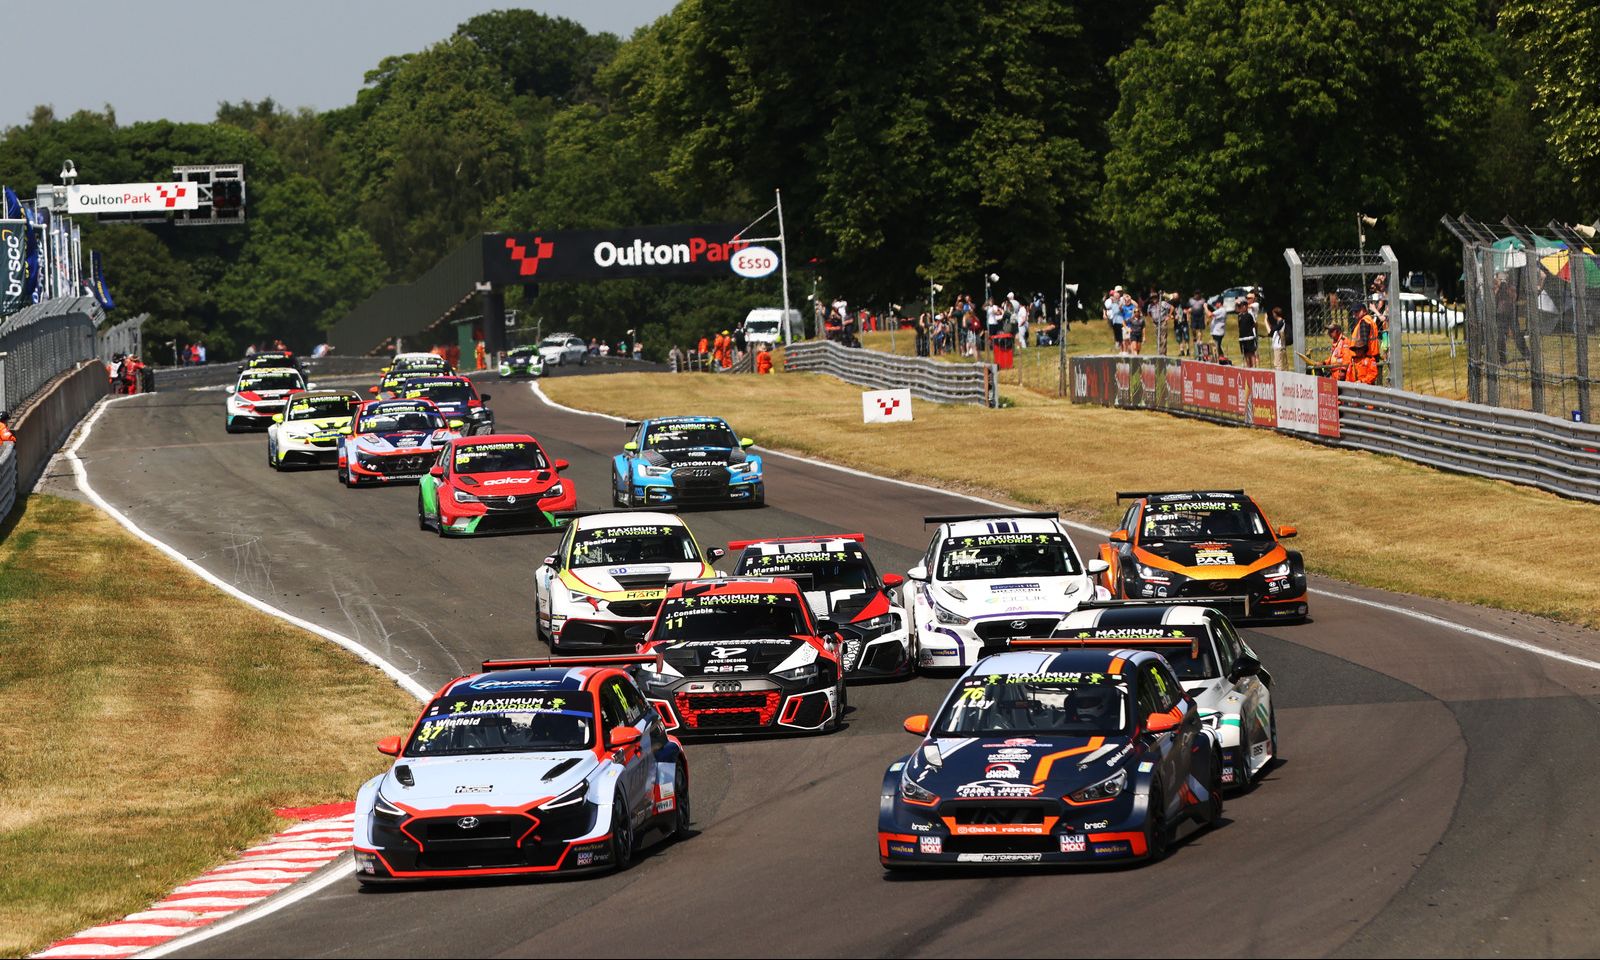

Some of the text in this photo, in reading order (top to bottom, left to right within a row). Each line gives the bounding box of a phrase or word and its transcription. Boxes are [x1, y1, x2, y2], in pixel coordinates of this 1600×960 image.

[79, 192, 152, 206] OultonPark
[5, 235, 22, 297] brscc
[670, 460, 728, 469] CUSTOMTAPE
[483, 477, 532, 486] aalco
[607, 526, 657, 534] MAXIMUM
[978, 534, 1033, 542] MAXIMUM
[775, 552, 831, 560] MAXIMUM
[949, 549, 981, 559] 117
[1196, 556, 1235, 564] PACE
[700, 594, 760, 602] MAXIMUM
[665, 617, 683, 630] 11
[1095, 628, 1164, 637] MAXIMUM
[1006, 672, 1082, 680] MAXIMUM
[959, 687, 986, 700] 76
[472, 697, 544, 706] MAXIMUM
[471, 703, 542, 712] NETWORKS
[436, 717, 481, 727] Winfield
[418, 726, 444, 742] 37
[1084, 821, 1107, 830] brscc
[920, 844, 942, 854] MOLY
[1061, 843, 1086, 852] MOLY
